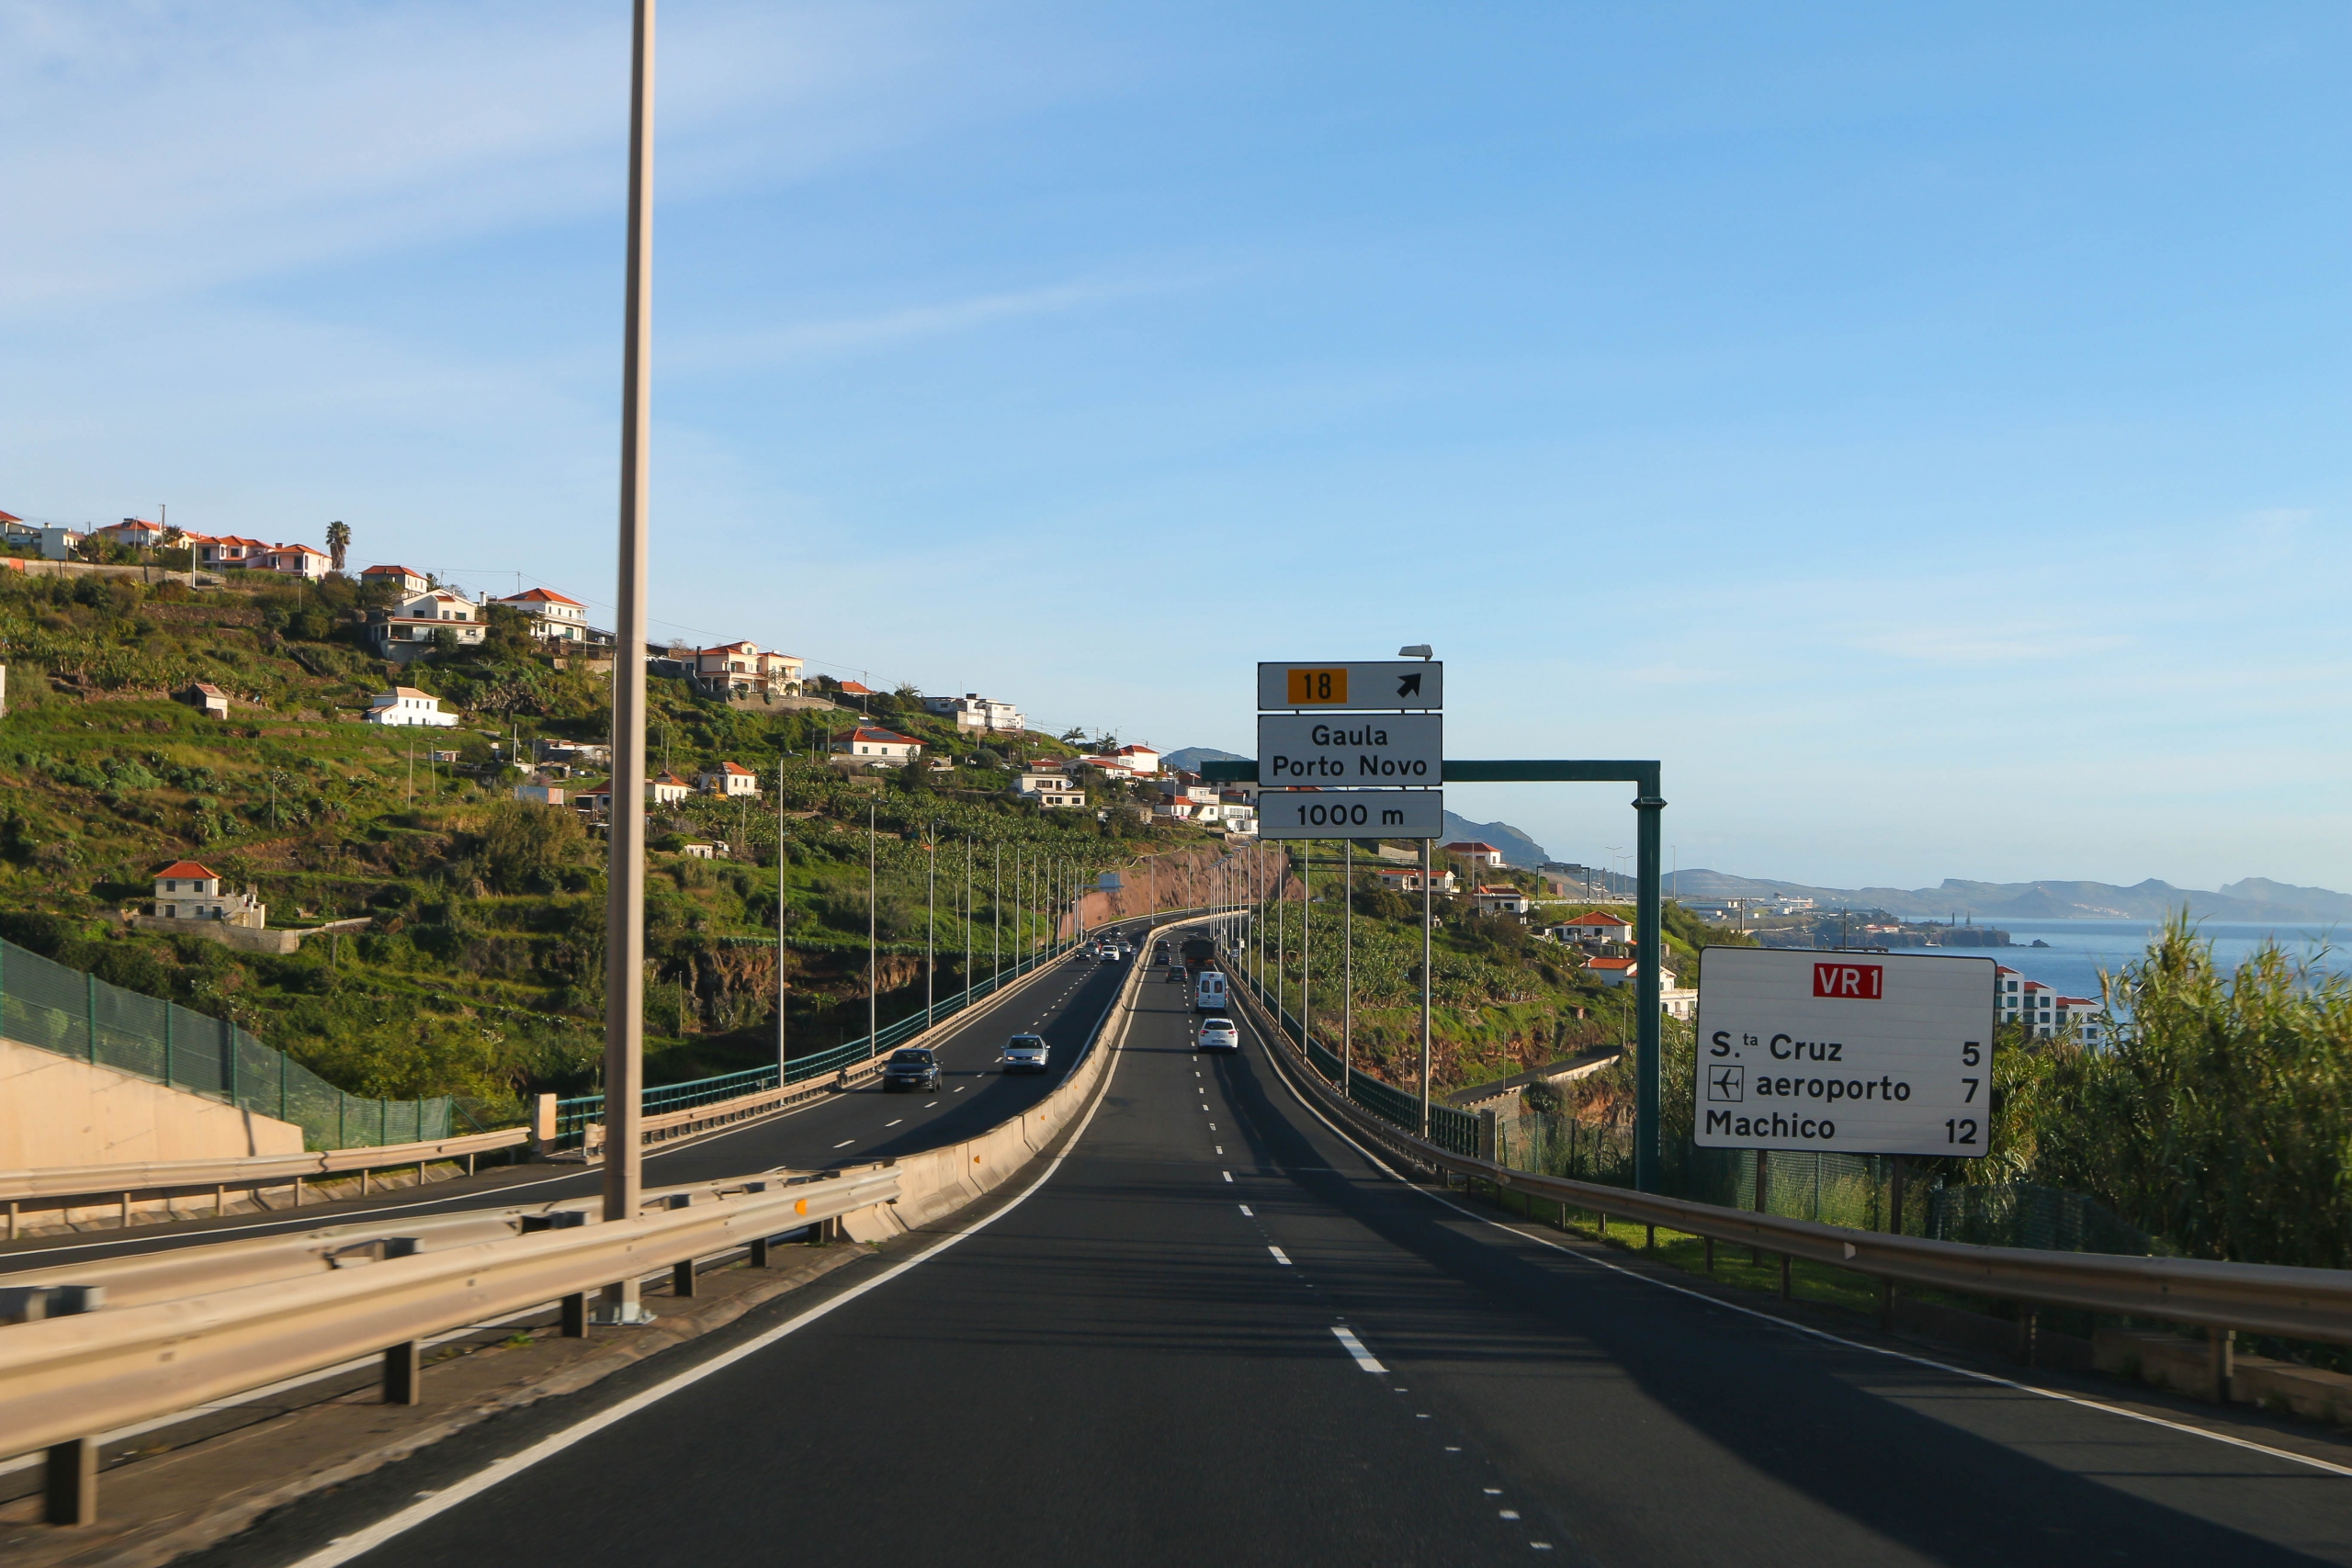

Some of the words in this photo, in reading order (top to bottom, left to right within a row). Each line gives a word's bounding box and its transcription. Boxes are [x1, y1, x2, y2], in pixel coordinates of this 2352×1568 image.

[1304, 672, 1331, 699] 18
[1312, 725, 1388, 746] Gaula
[1273, 756, 1344, 776] Porto
[1360, 755, 1428, 776] Novo
[1297, 805, 1368, 826] 1000
[1382, 809, 1404, 825] m
[1818, 967, 1860, 995] VR
[1871, 969, 1879, 996] 1
[1770, 1033, 1842, 1062] Cruz
[1962, 1041, 1981, 1066] 5
[1756, 1076, 1911, 1103] aeroporto
[1962, 1078, 1979, 1103] 7
[1706, 1110, 1836, 1139] Machico
[1945, 1119, 1977, 1144] 12
